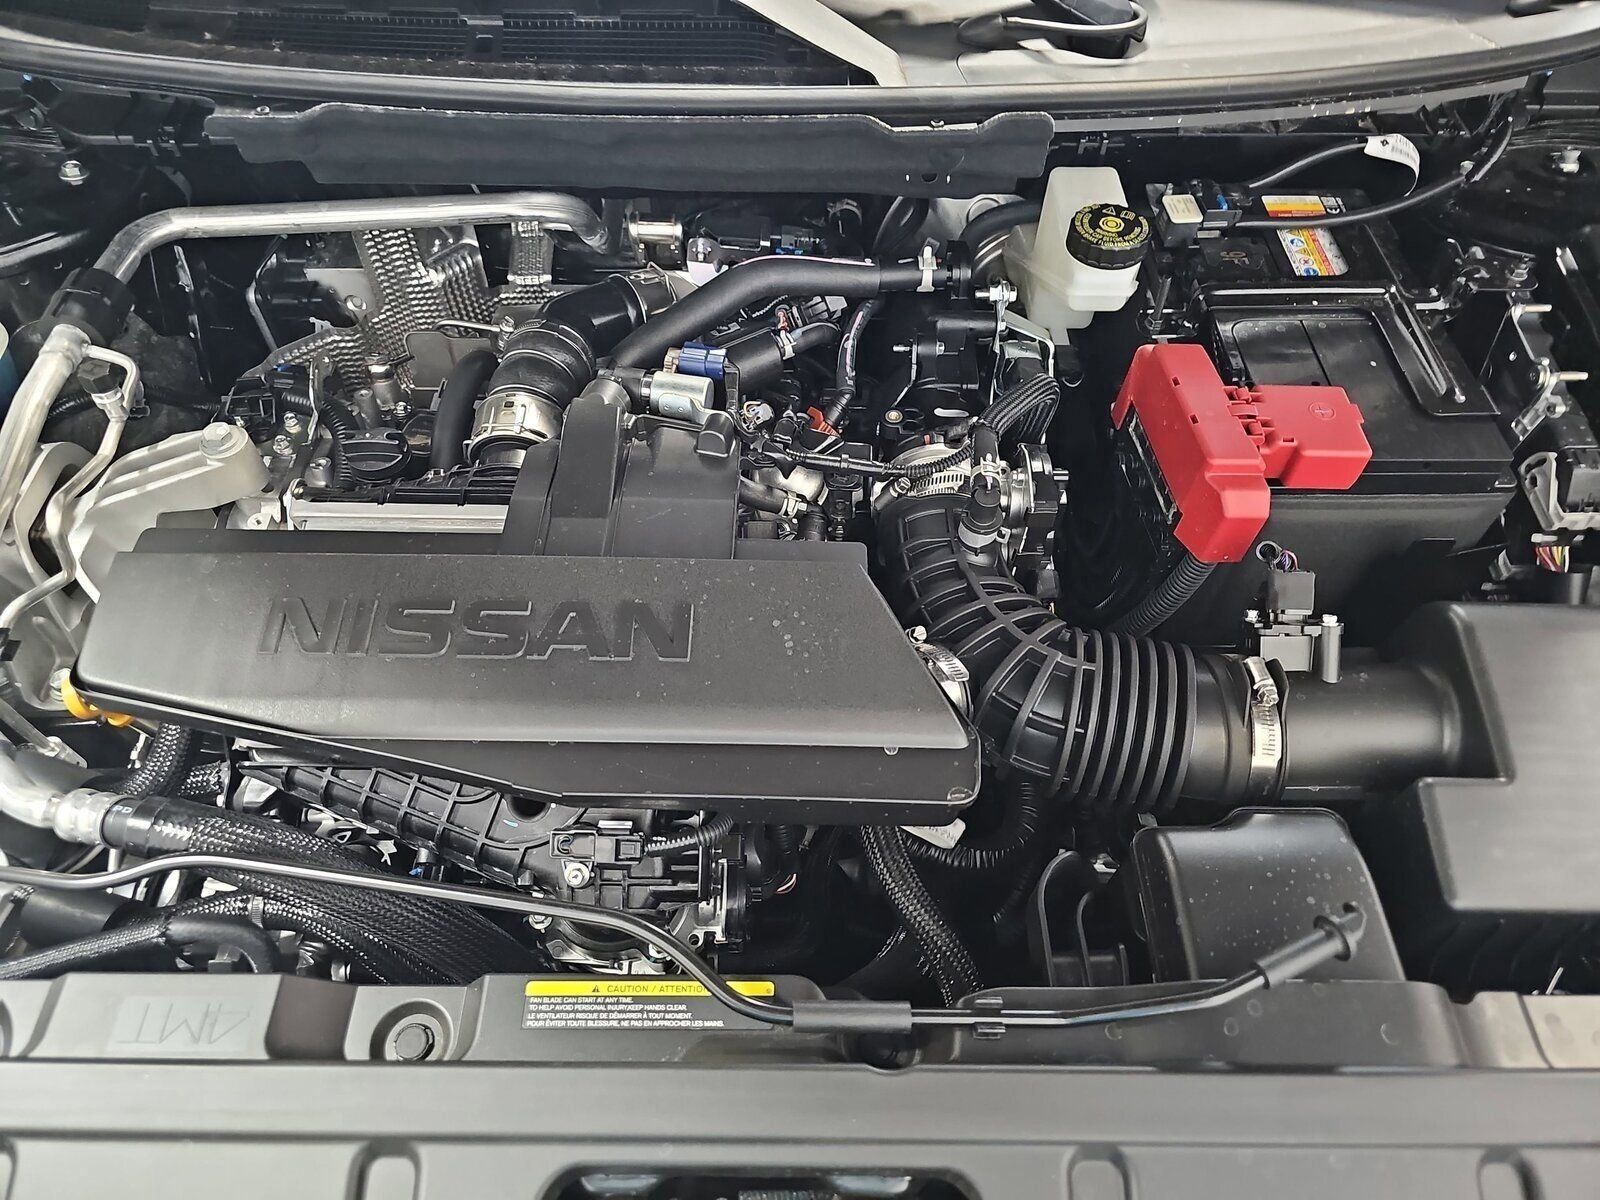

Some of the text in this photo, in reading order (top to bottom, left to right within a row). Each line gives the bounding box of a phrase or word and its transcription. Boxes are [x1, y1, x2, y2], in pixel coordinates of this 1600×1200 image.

[256, 597, 694, 662] NISSAN
[607, 985, 647, 993] CAUTION
[659, 985, 706, 993] ATTENTIO
[609, 1011, 642, 1019] DÉMARRER
[643, 1011, 648, 1019] À
[546, 1019, 566, 1027] ÉVITER
